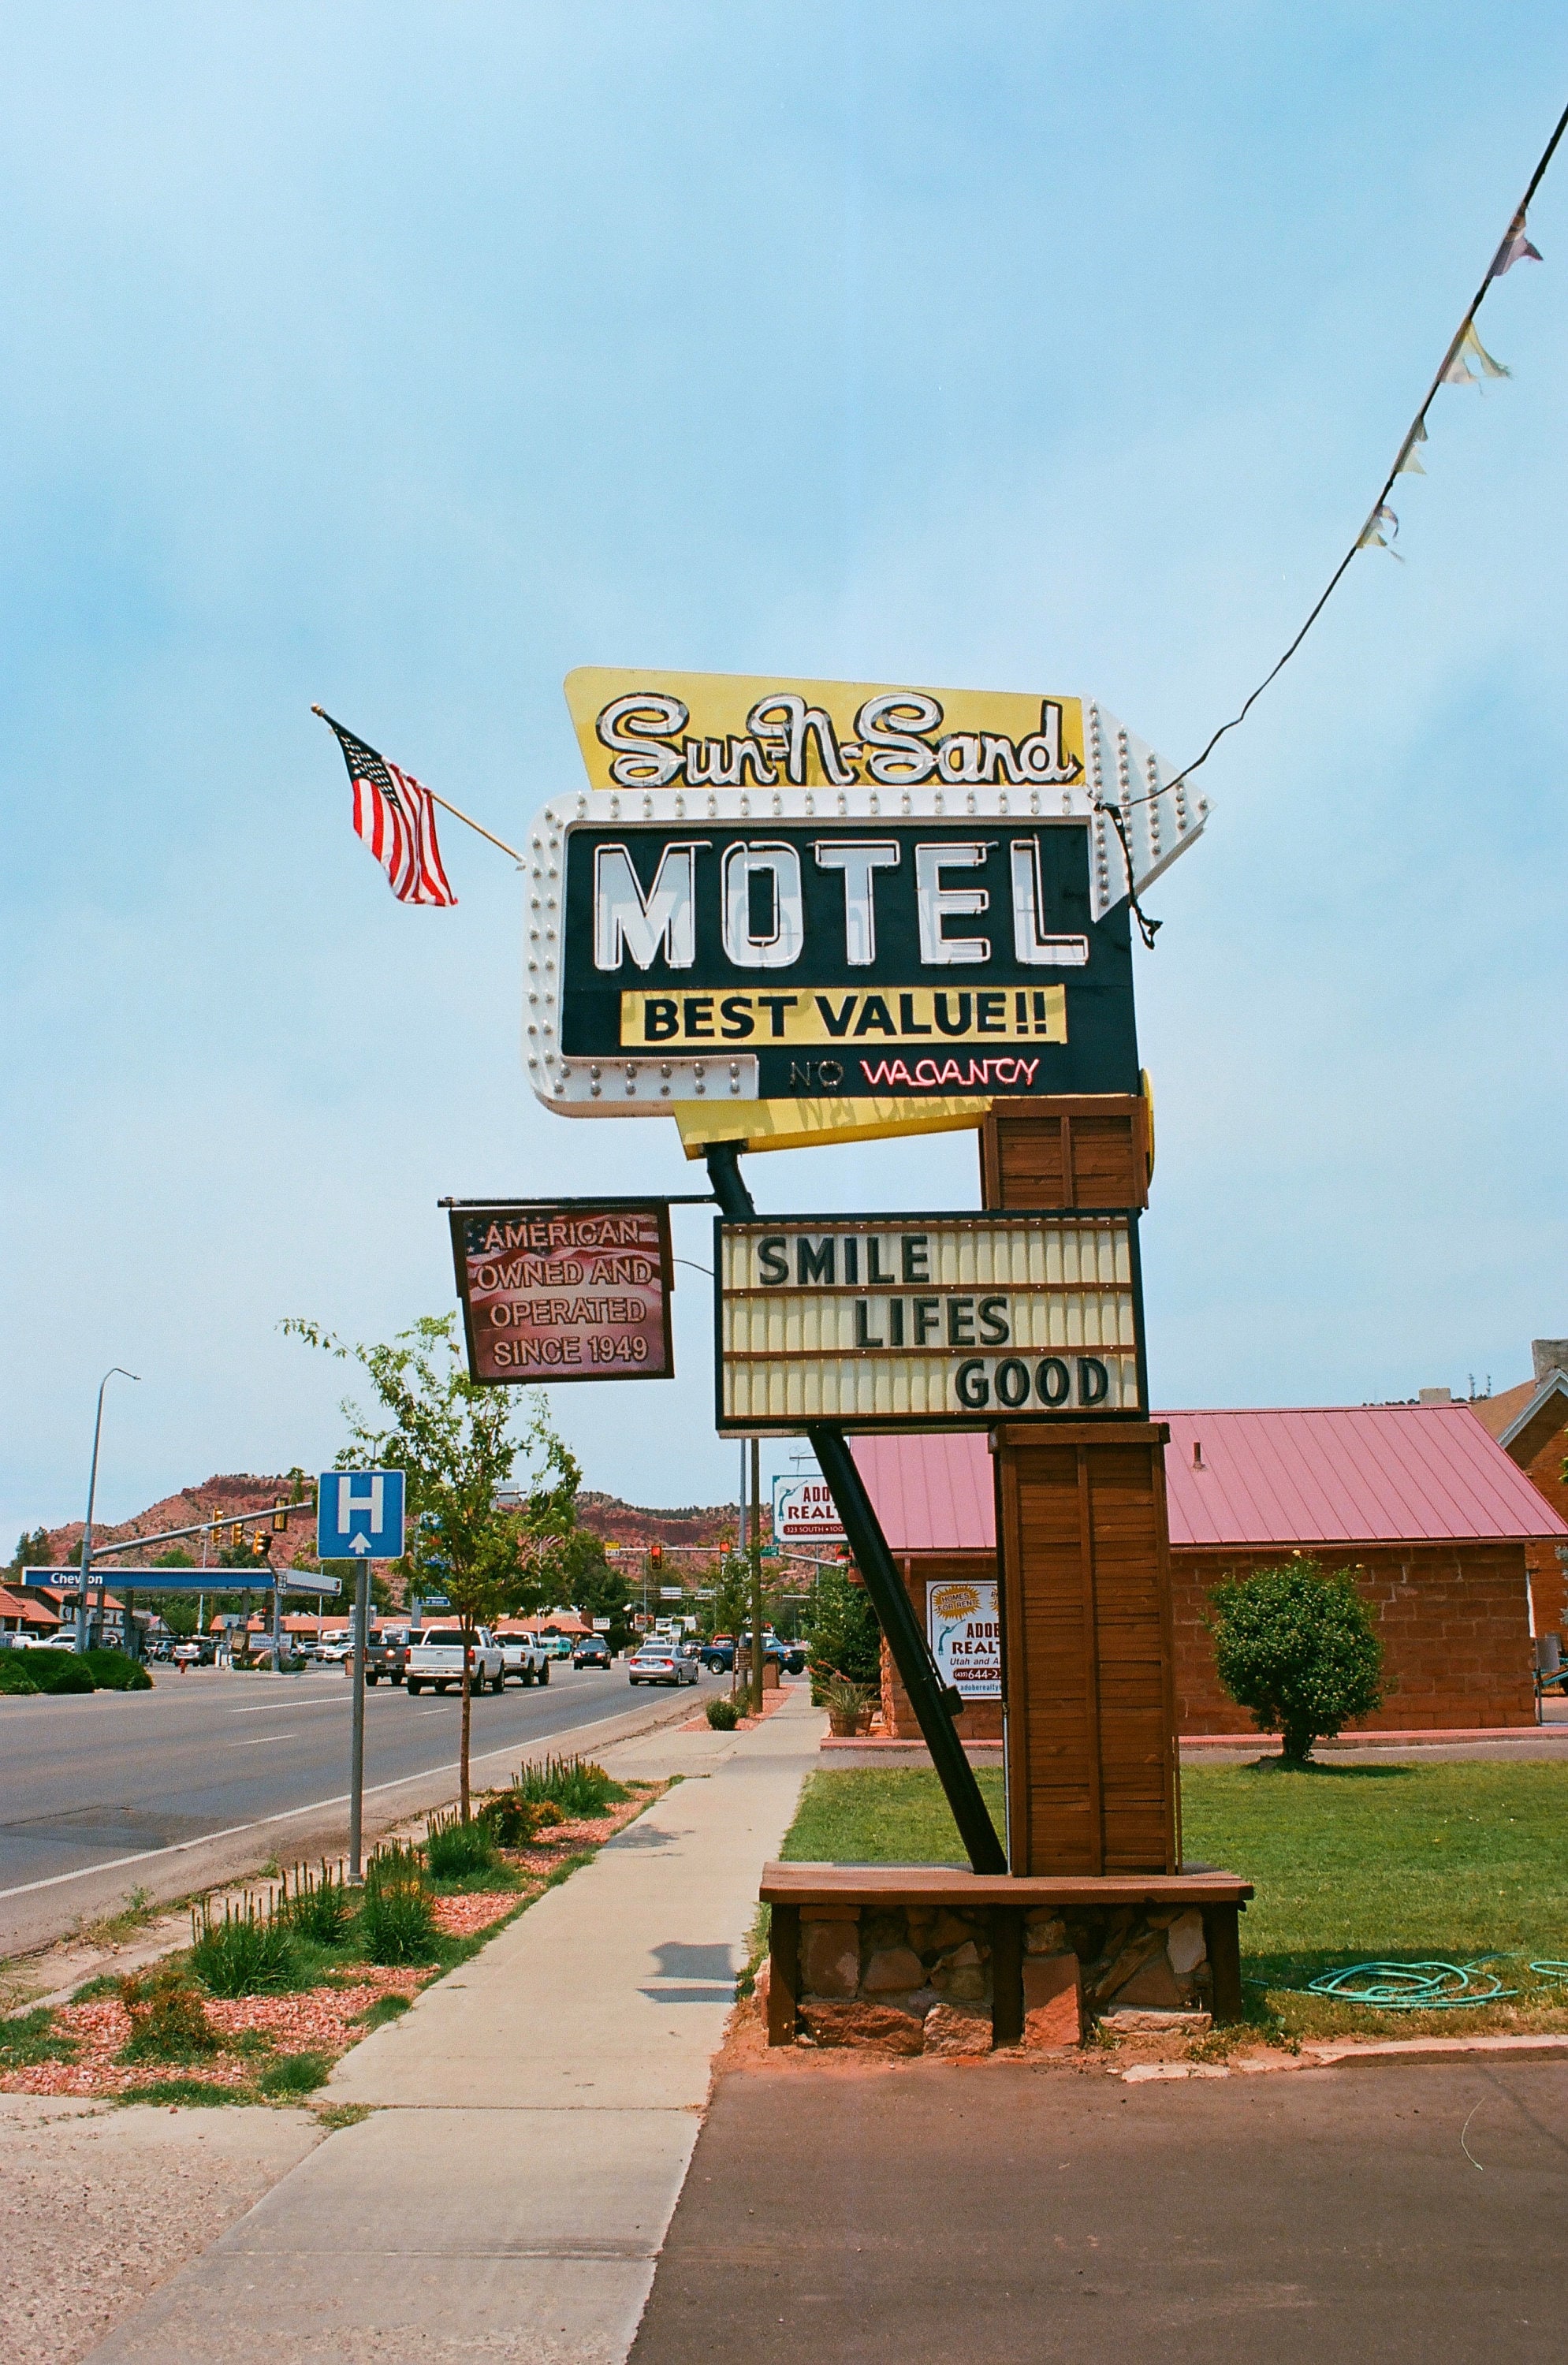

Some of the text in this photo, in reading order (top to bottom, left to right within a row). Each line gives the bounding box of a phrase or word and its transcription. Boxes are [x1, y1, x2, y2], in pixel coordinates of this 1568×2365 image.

[593, 836, 1090, 971] MOTEL
[642, 992, 1048, 1042] BEST VALUE!!
[790, 1058, 1040, 1087] NO VACANCY
[482, 1220, 641, 1252] AMERICAN
[476, 1258, 654, 1291] OWNED AND
[758, 1234, 931, 1287] SMILE
[489, 1297, 647, 1328] OPERATED
[854, 1296, 1011, 1349] LIFES
[493, 1335, 648, 1368] SINCE 1949
[954, 1356, 1110, 1409] GOOD
[337, 1476, 385, 1534] H
[803, 1486, 832, 1503] ADO
[788, 1505, 837, 1520] REAL
[50, 1572, 103, 1585] Chevon
[937, 1599, 977, 1612] FOR RENT
[941, 1592, 970, 1603] HOMES
[966, 1622, 1000, 1638] ADOB
[950, 1657, 970, 1666] Utah
[973, 1657, 990, 1666] and
[952, 1641, 1000, 1655] REAL
